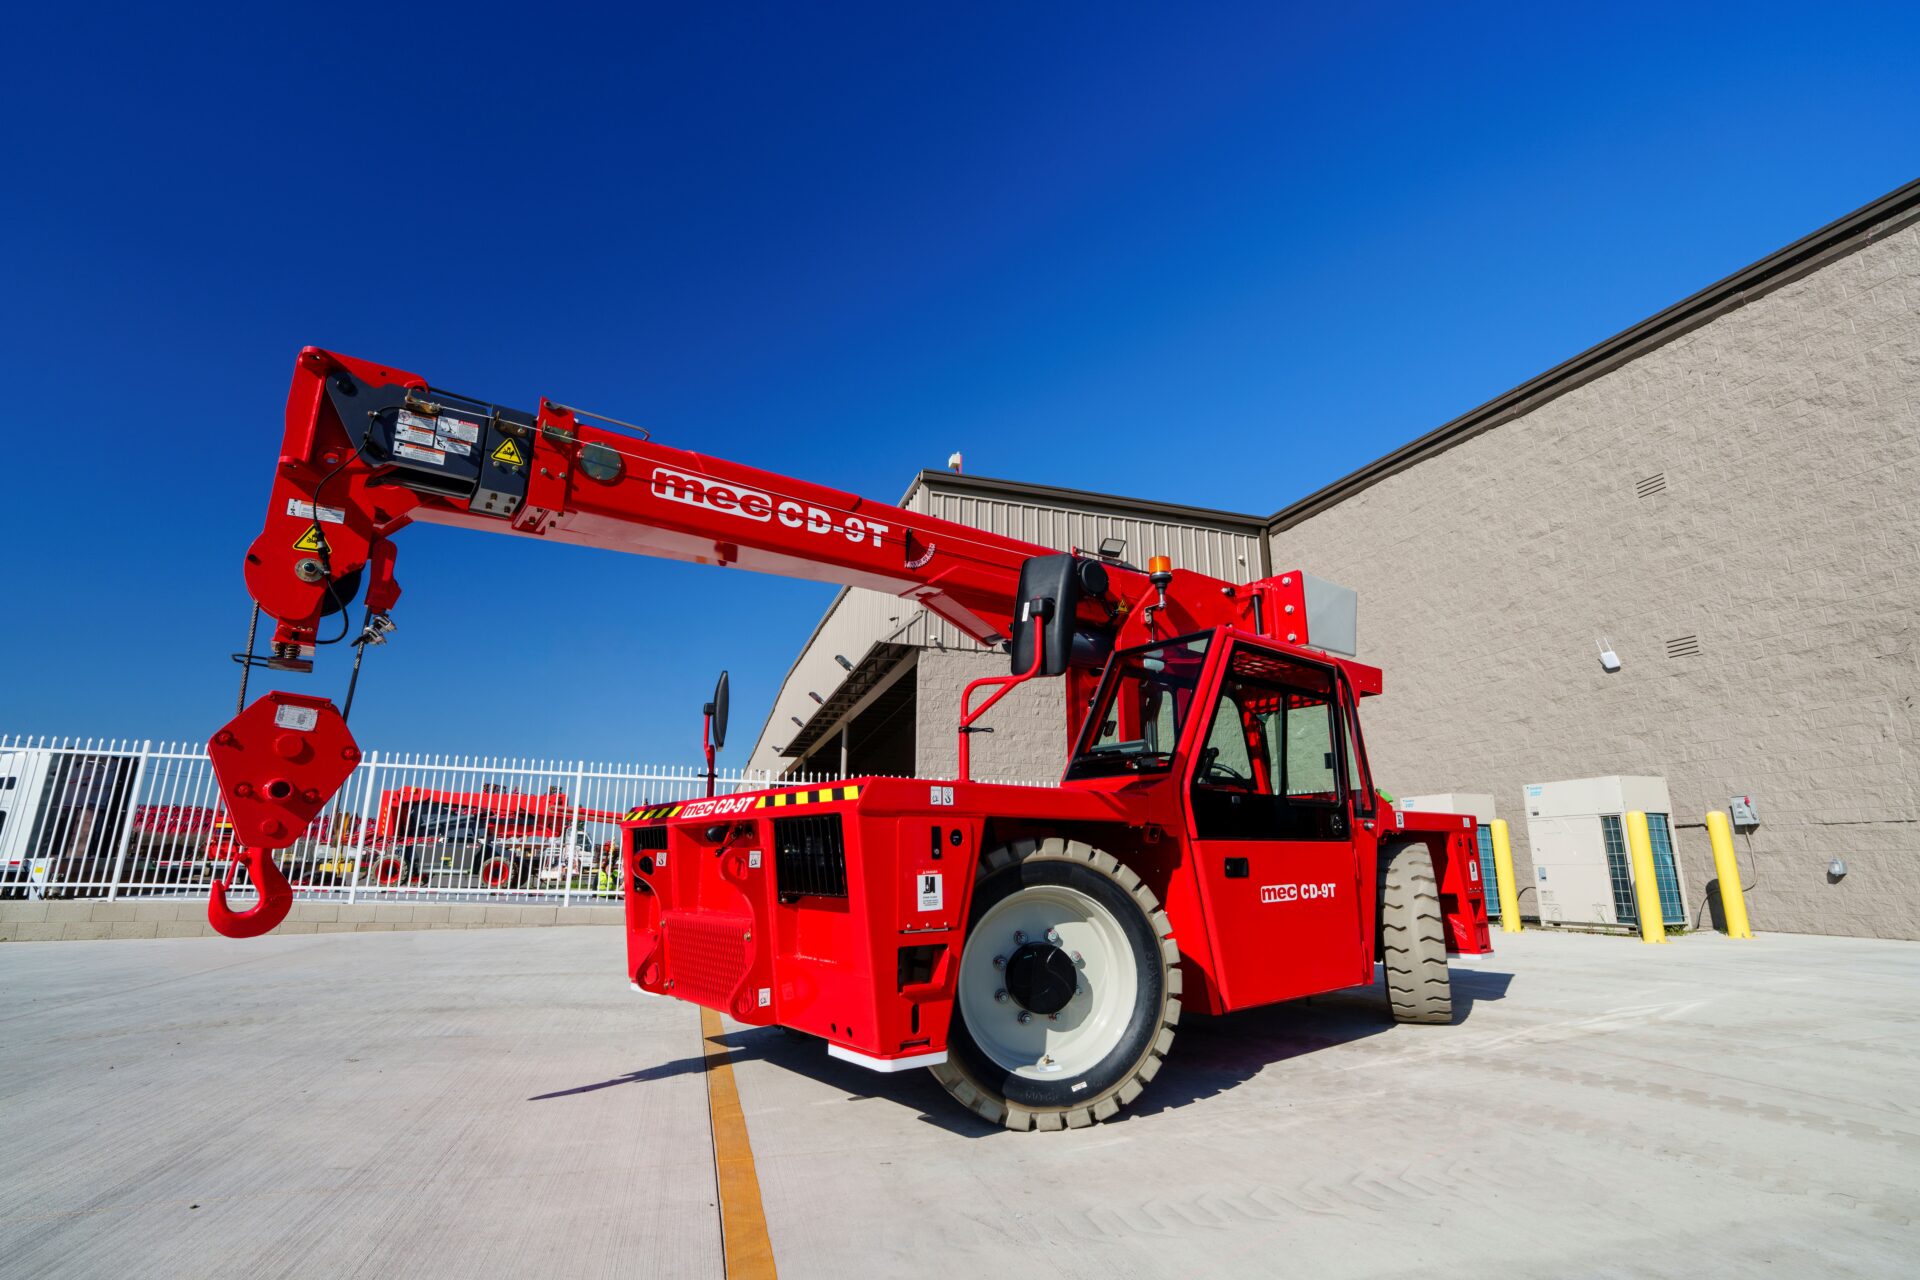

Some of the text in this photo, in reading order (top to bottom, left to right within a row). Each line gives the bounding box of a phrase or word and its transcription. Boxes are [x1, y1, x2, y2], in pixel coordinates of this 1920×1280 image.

[653, 469, 889, 548] mec CD-9T
[714, 796, 756, 814] CD-9T
[1261, 883, 1336, 902] mec CD-9T
